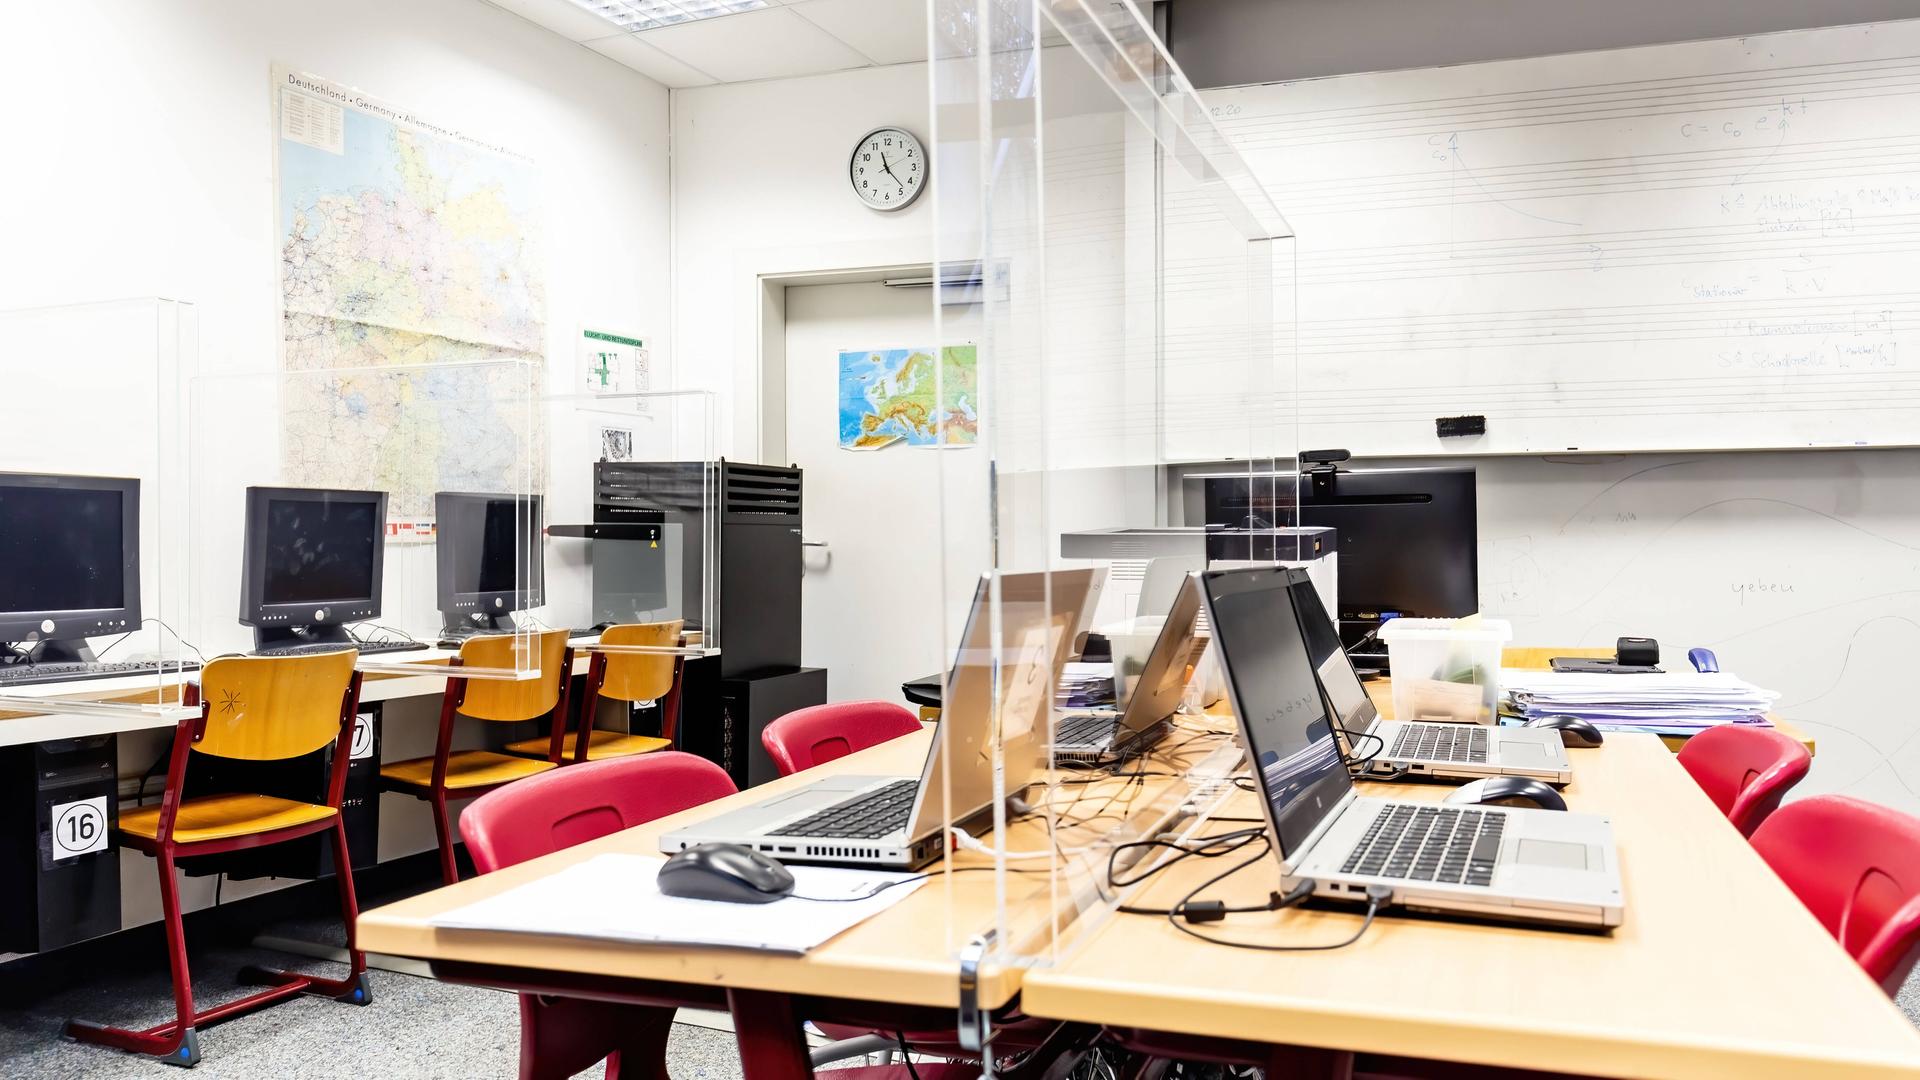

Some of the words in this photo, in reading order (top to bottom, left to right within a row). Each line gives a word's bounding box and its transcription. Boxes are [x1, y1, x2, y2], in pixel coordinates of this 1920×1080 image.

[288, 73, 347, 102] Deutschland
[355, 97, 396, 120] Germany
[884, 138, 892, 146] 12
[872, 143, 879, 151] 11
[907, 149, 913, 157] 2
[863, 153, 871, 162] 10
[859, 167, 864, 175] 9
[911, 163, 917, 171] 3
[862, 180, 868, 188] 8
[907, 176, 913, 184] 4
[872, 189, 877, 197] 7
[898, 187, 904, 196] 5
[884, 192, 890, 200] 6
[67, 813, 95, 843] 16
